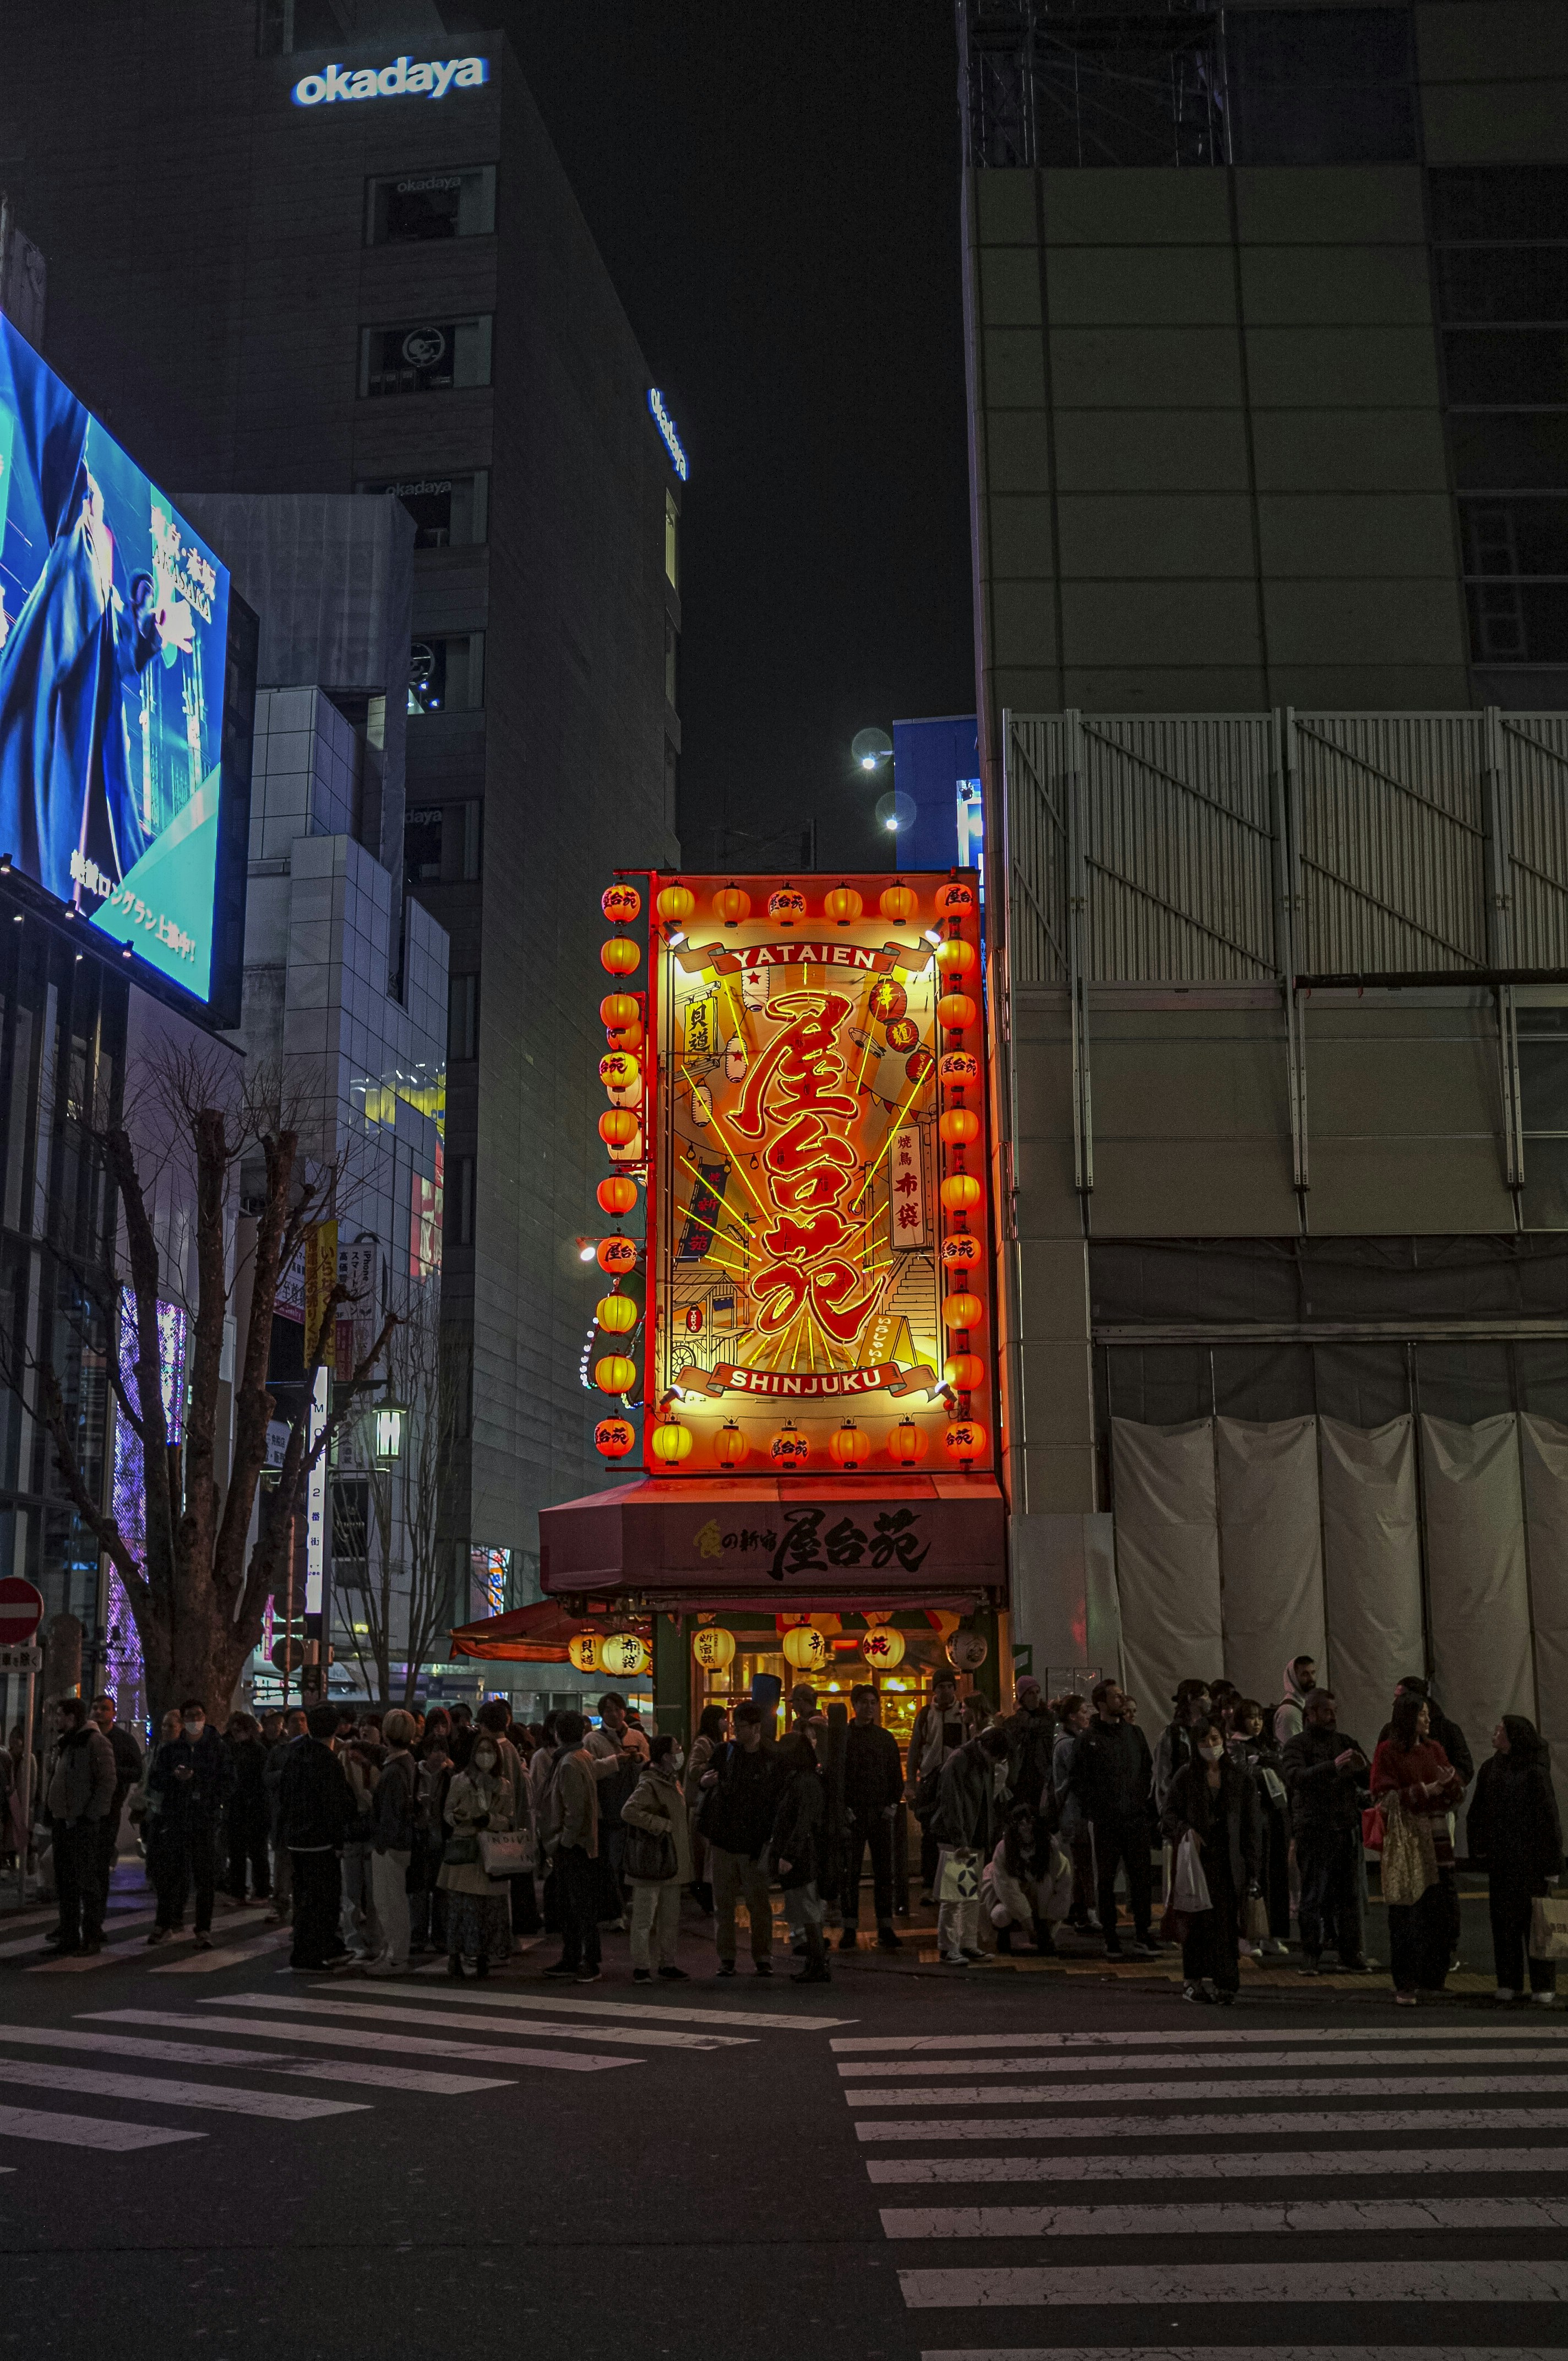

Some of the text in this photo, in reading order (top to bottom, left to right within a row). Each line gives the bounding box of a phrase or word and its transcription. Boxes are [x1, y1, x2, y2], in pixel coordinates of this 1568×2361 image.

[297, 57, 482, 104] okadaya
[397, 177, 461, 192] okadaya
[385, 480, 451, 496] okadaya
[769, 894, 804, 914] 屋台苑
[945, 886, 973, 907] 屋台
[731, 944, 875, 970] YATAIEN
[688, 1003, 711, 1052] 貝道
[940, 1056, 977, 1077] 屋台苑
[728, 991, 888, 1345] 屋台苑
[363, 1250, 372, 1282] iPhone
[351, 1252, 360, 1315] スマートフン
[730, 1369, 881, 1394] SHINJUKU
[771, 1438, 808, 1460] 屋台苑
[581, 1639, 595, 1665] 貝道
[620, 1639, 638, 1669] 布袋
[699, 1634, 715, 1663] 新宿苑
